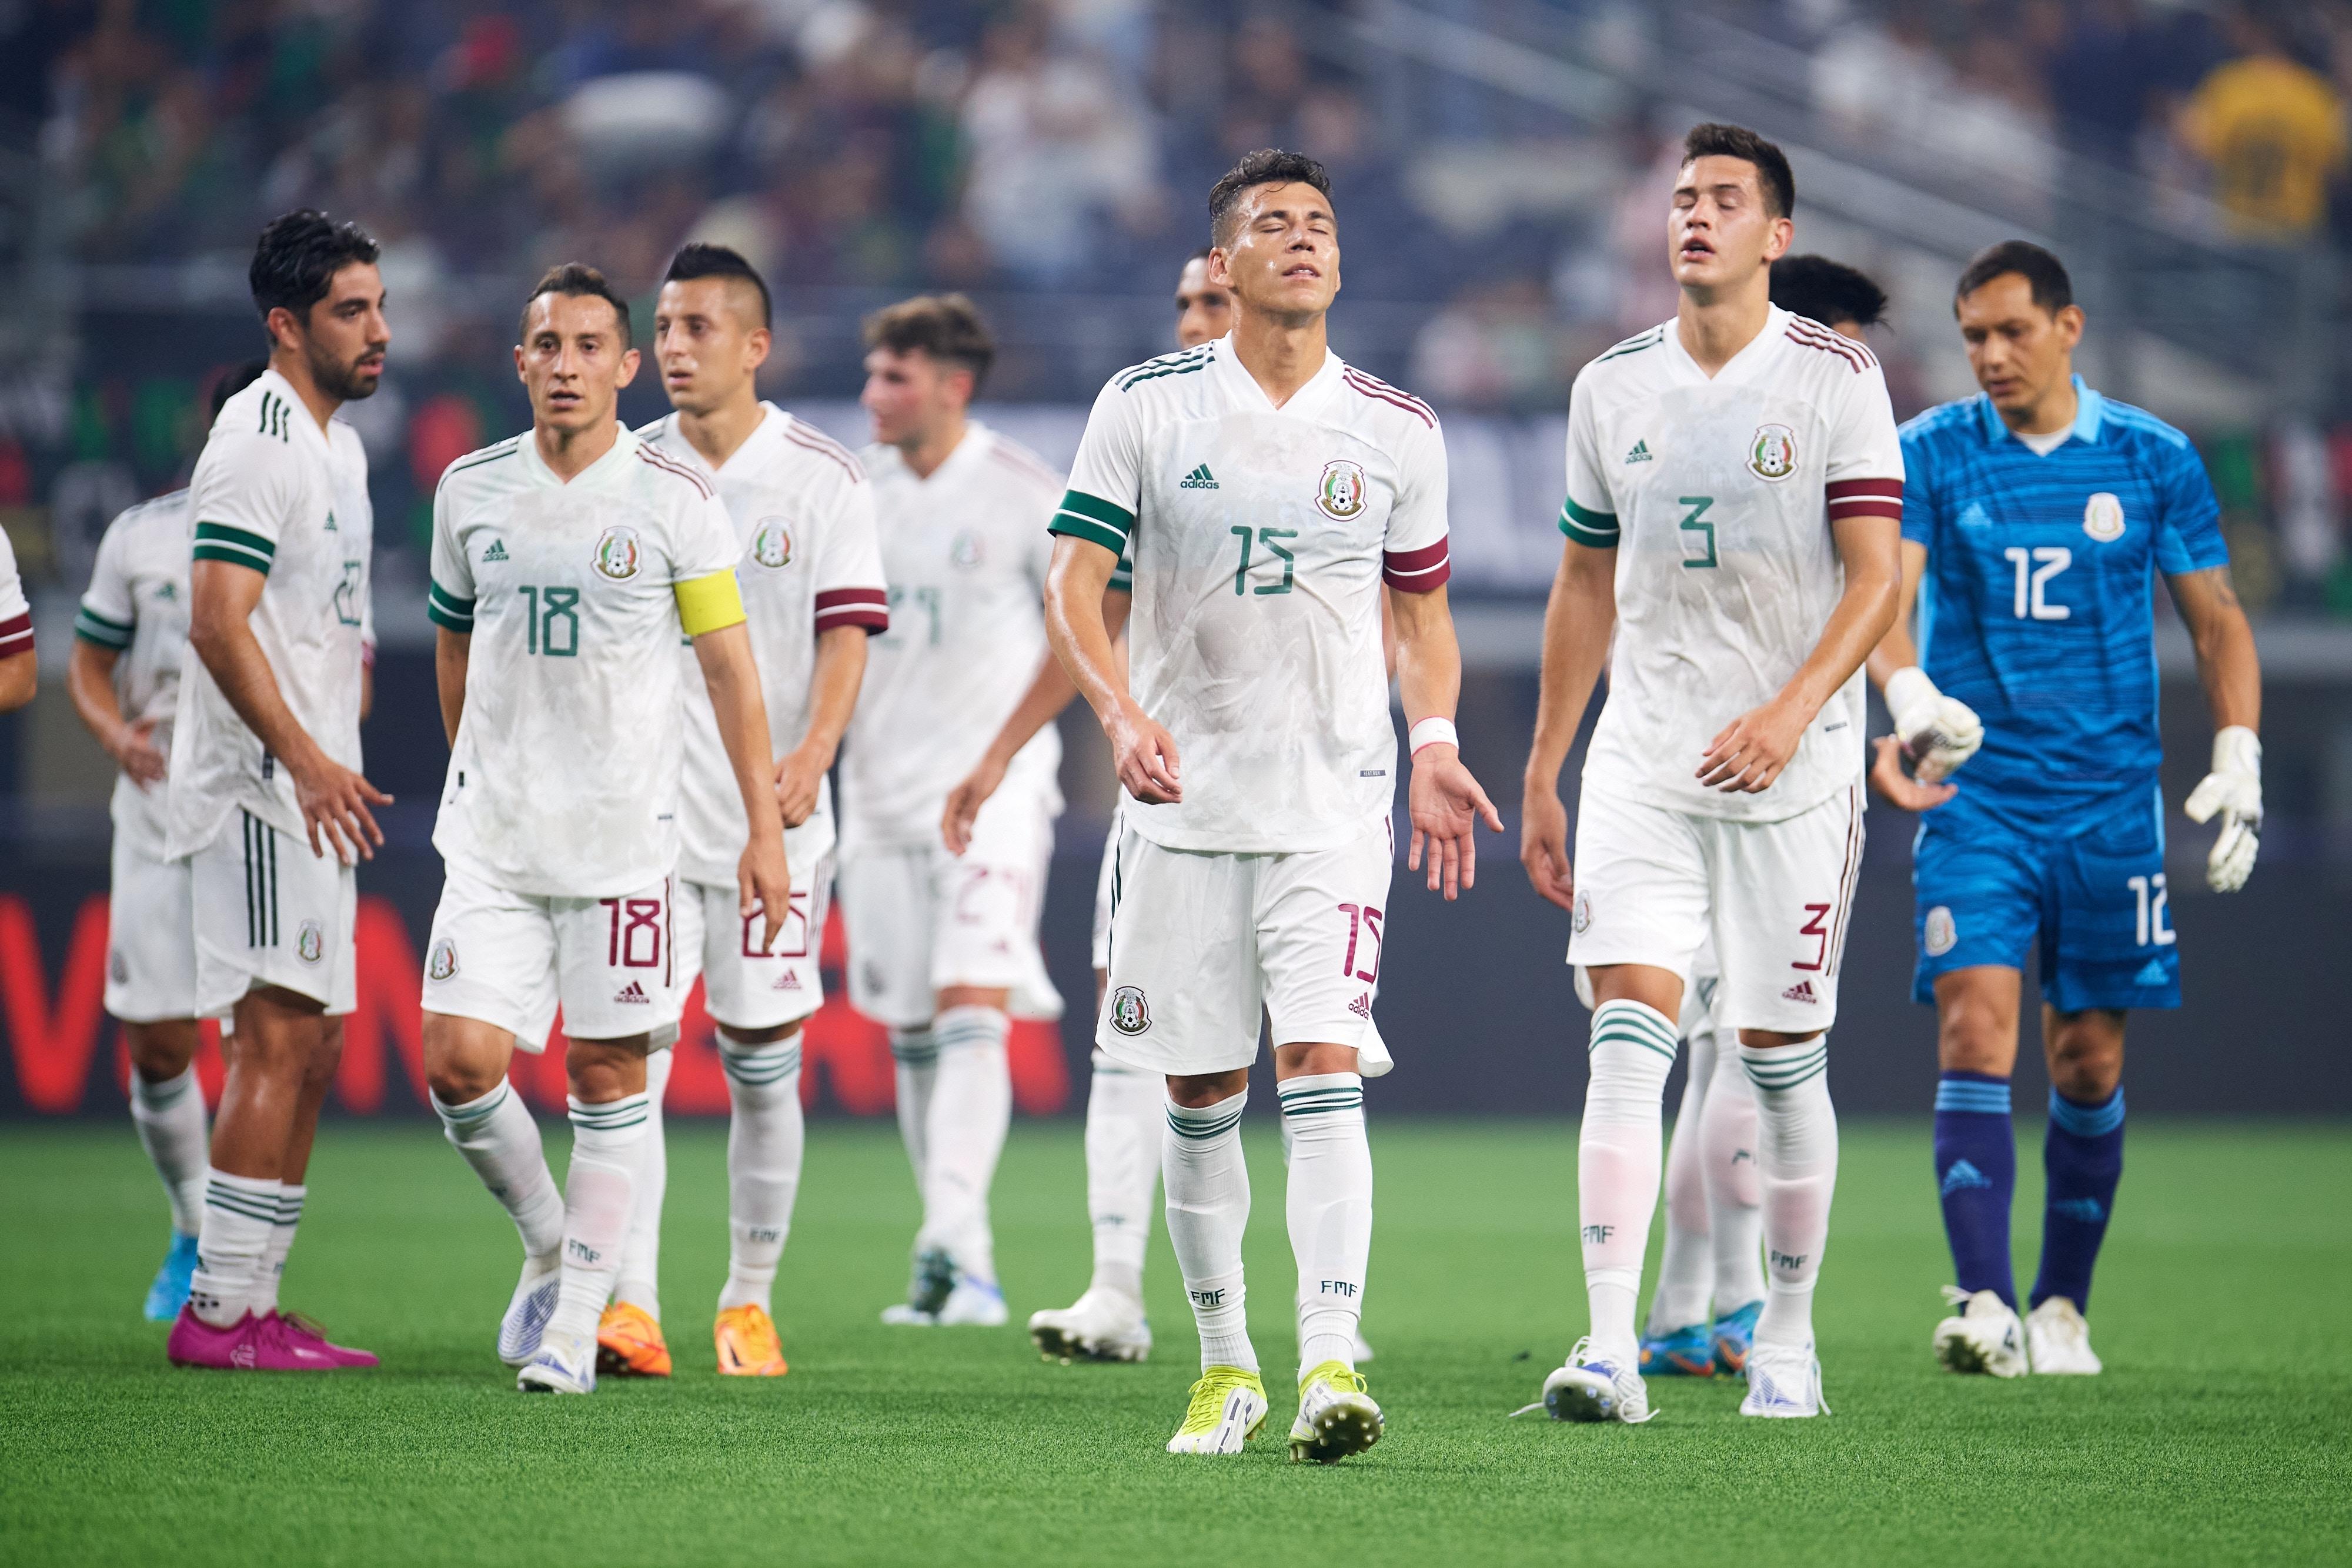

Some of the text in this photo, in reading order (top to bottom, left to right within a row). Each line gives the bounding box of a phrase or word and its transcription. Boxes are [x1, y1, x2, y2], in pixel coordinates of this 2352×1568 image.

[1180, 479, 1220, 489] adidas
[1231, 526, 1298, 596] 15
[1679, 496, 1716, 567] 3
[2004, 547, 2072, 620] 12
[519, 586, 579, 657] 18
[600, 899, 660, 967] 18
[1792, 904, 1832, 970] 3
[2127, 873, 2176, 946] 12
[1338, 903, 1382, 985] 15
[1581, 1225, 1615, 1243] FMF
[1771, 1250, 1809, 1269] FMF
[1191, 1288, 1225, 1305] FMF
[1321, 1281, 1358, 1298] FMF
